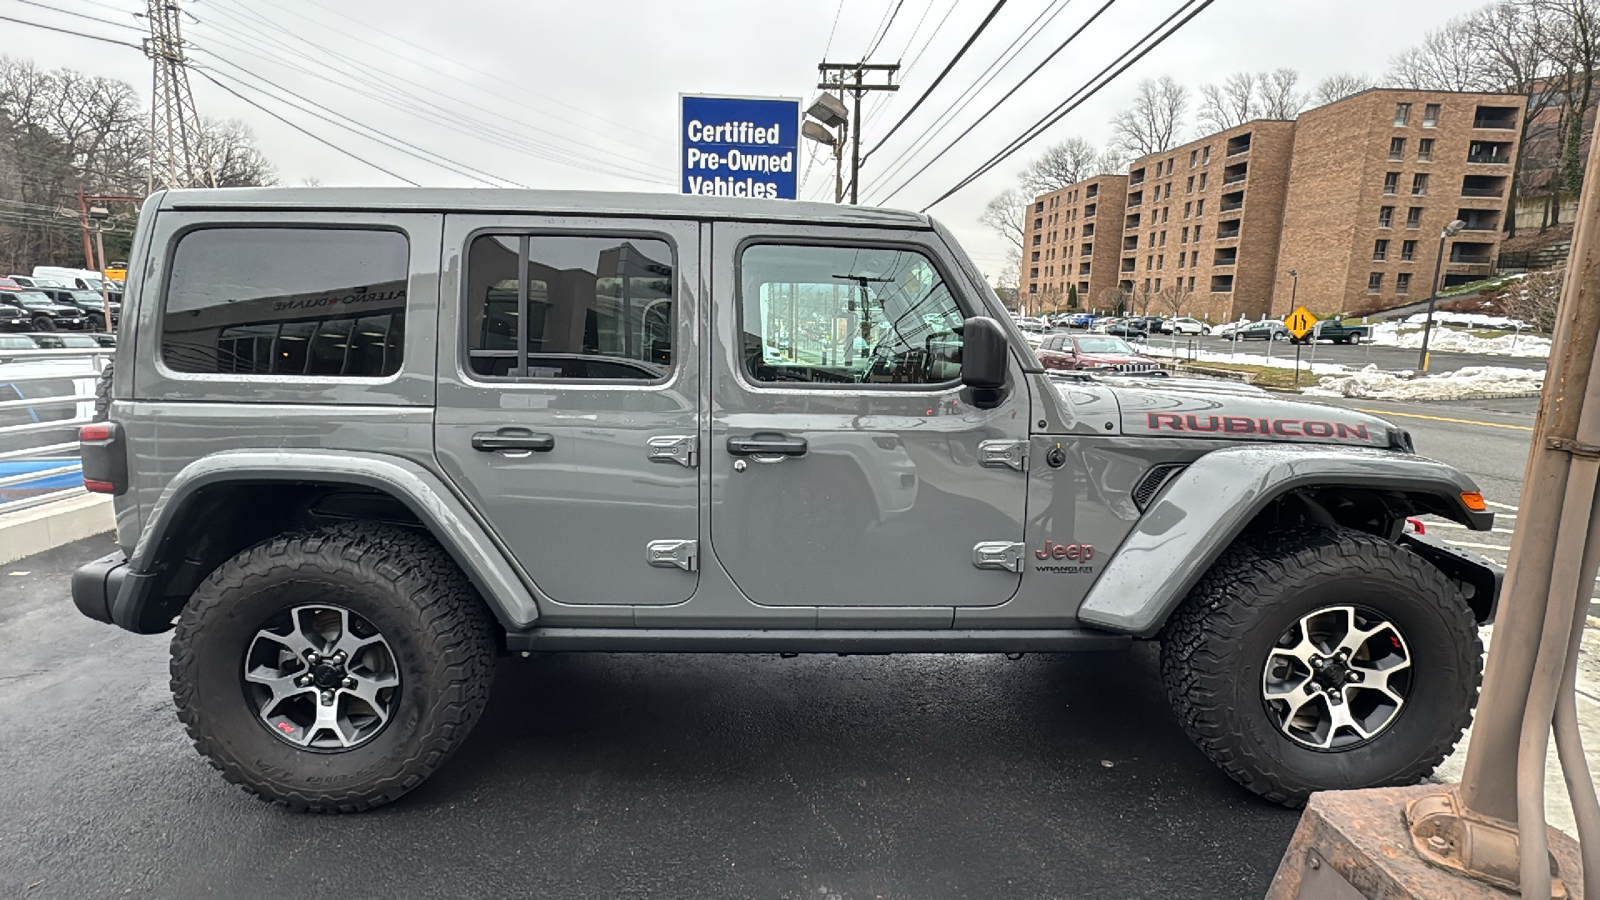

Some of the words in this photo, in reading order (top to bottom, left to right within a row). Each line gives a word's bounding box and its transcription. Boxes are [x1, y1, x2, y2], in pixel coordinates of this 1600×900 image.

[687, 119, 779, 145] Certified
[687, 148, 793, 173] Pre-Owned
[687, 175, 778, 199] Vehicles
[1146, 412, 1371, 441] RUBICON
[1035, 539, 1094, 564] Jeep
